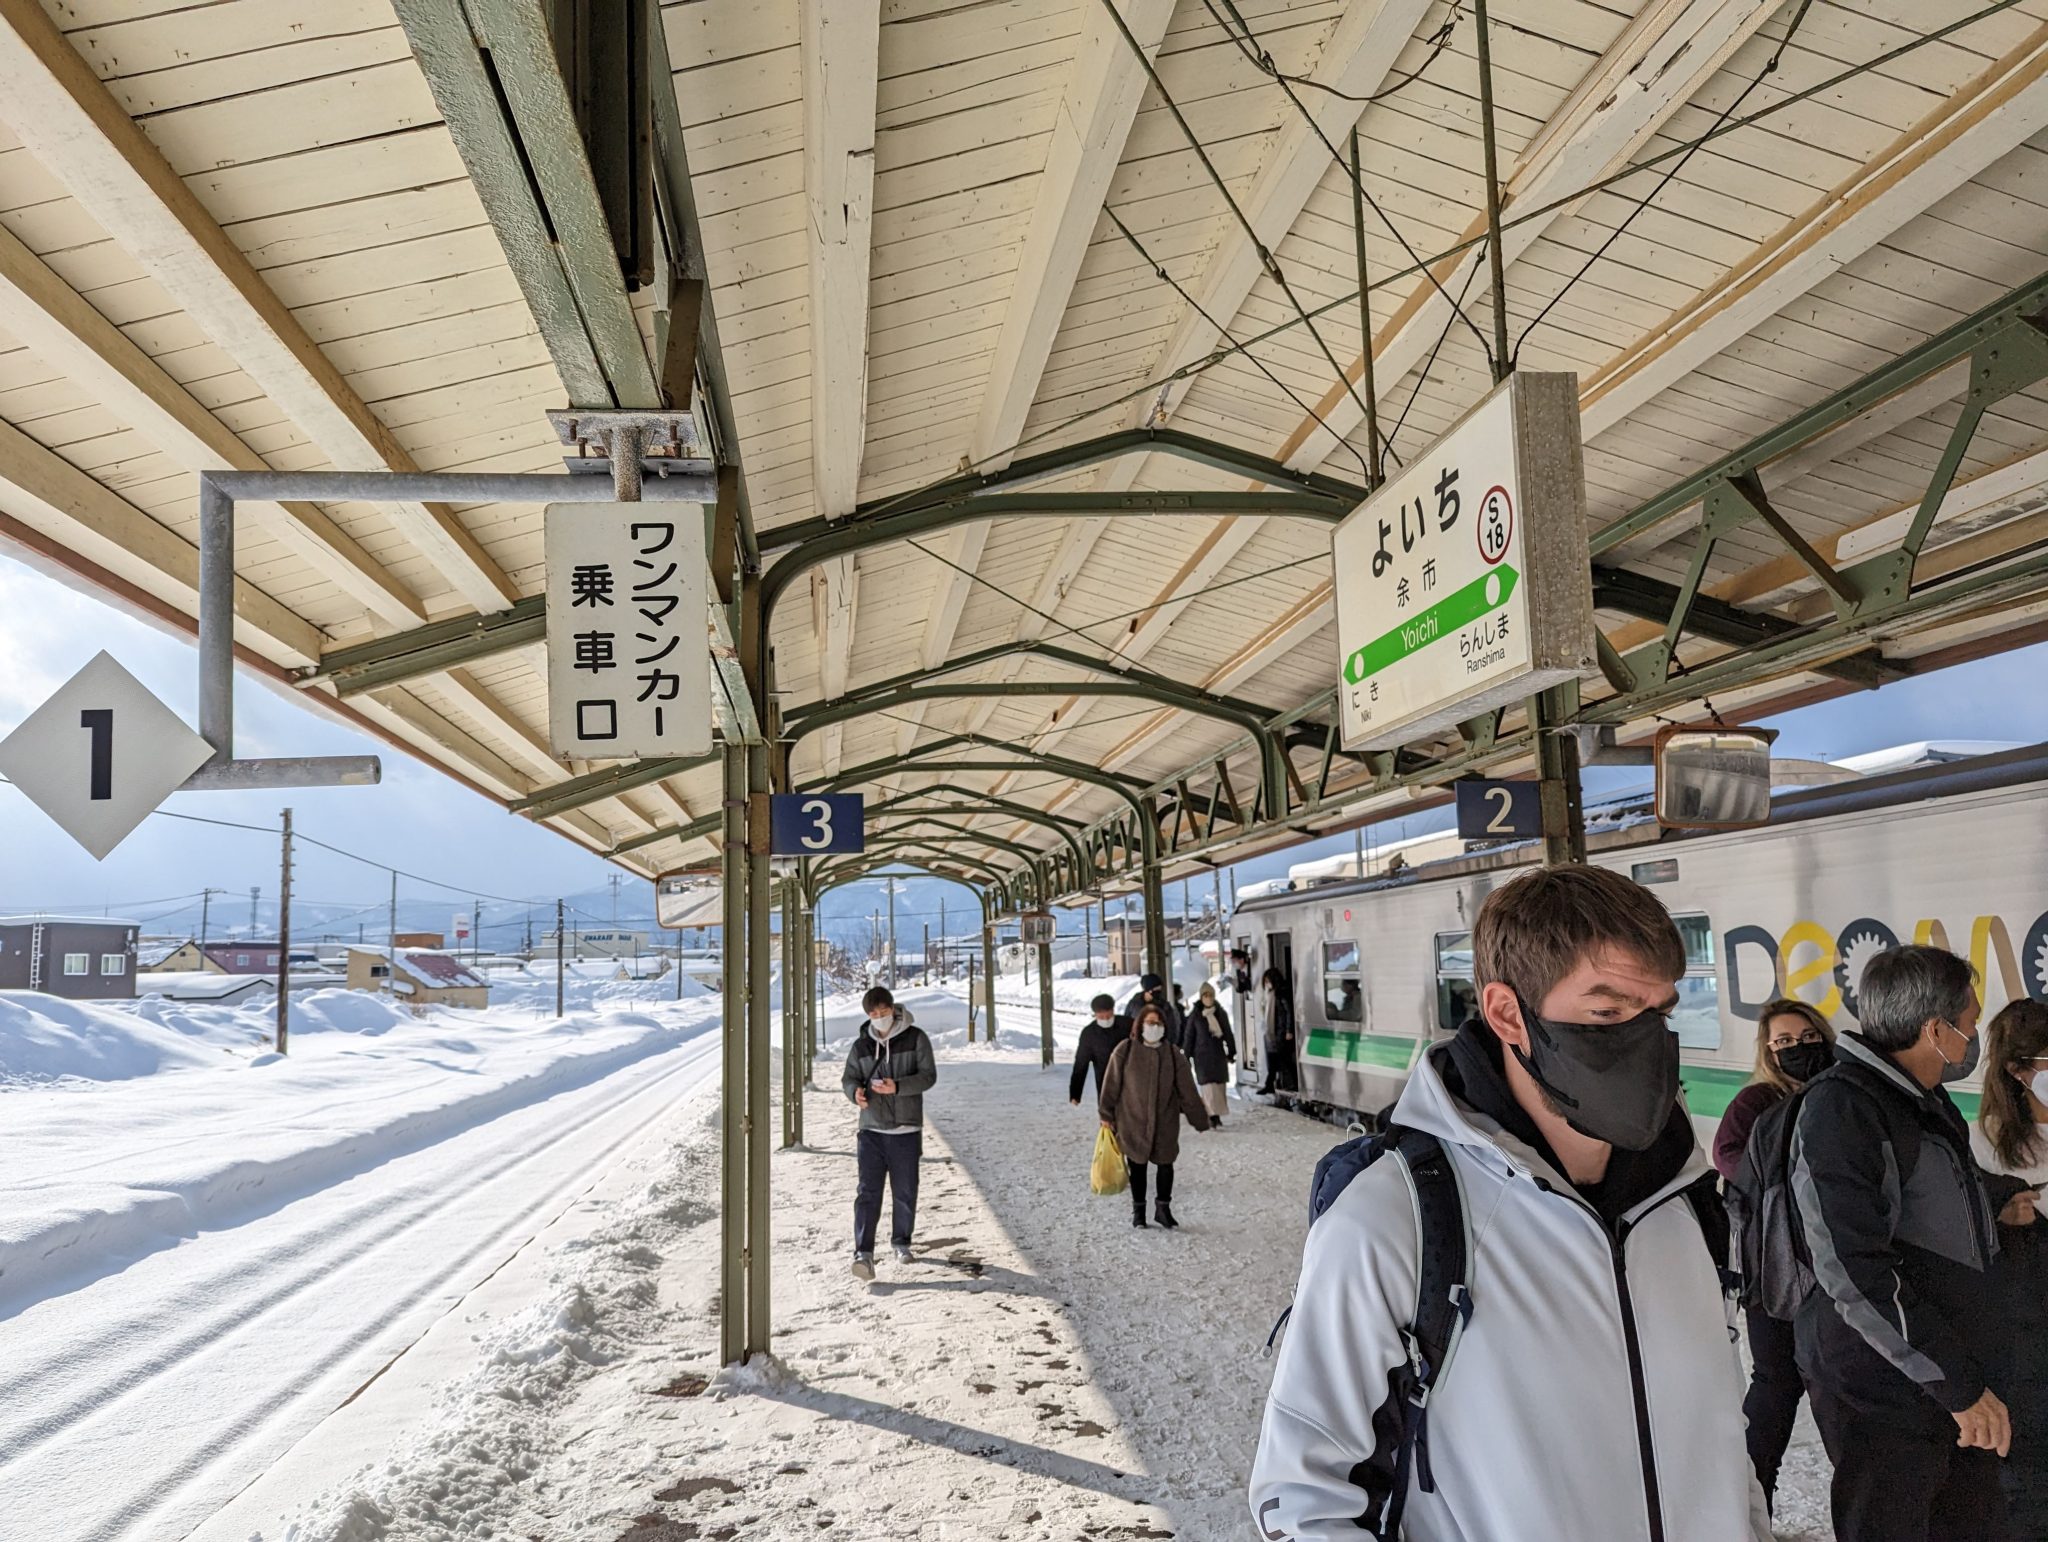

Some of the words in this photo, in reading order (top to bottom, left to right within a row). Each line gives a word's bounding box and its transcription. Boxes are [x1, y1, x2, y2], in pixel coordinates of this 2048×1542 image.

[1372, 467, 1460, 578] よいち
[1489, 496, 1499, 524] S
[1486, 523, 1504, 553] 18
[1397, 558, 1436, 607] 余市
[571, 564, 617, 740] 乗車口
[631, 523, 680, 736] ワンマンカー
[1401, 611, 1439, 651] Yoichi
[1460, 612, 1510, 658] らんしま
[1466, 648, 1506, 674] Ranshima
[1352, 680, 1379, 711] にき
[81, 709, 113, 800] 1
[800, 800, 833, 849] 3
[1484, 787, 1516, 833] 2
[1029, 947, 1036, 956] 3
